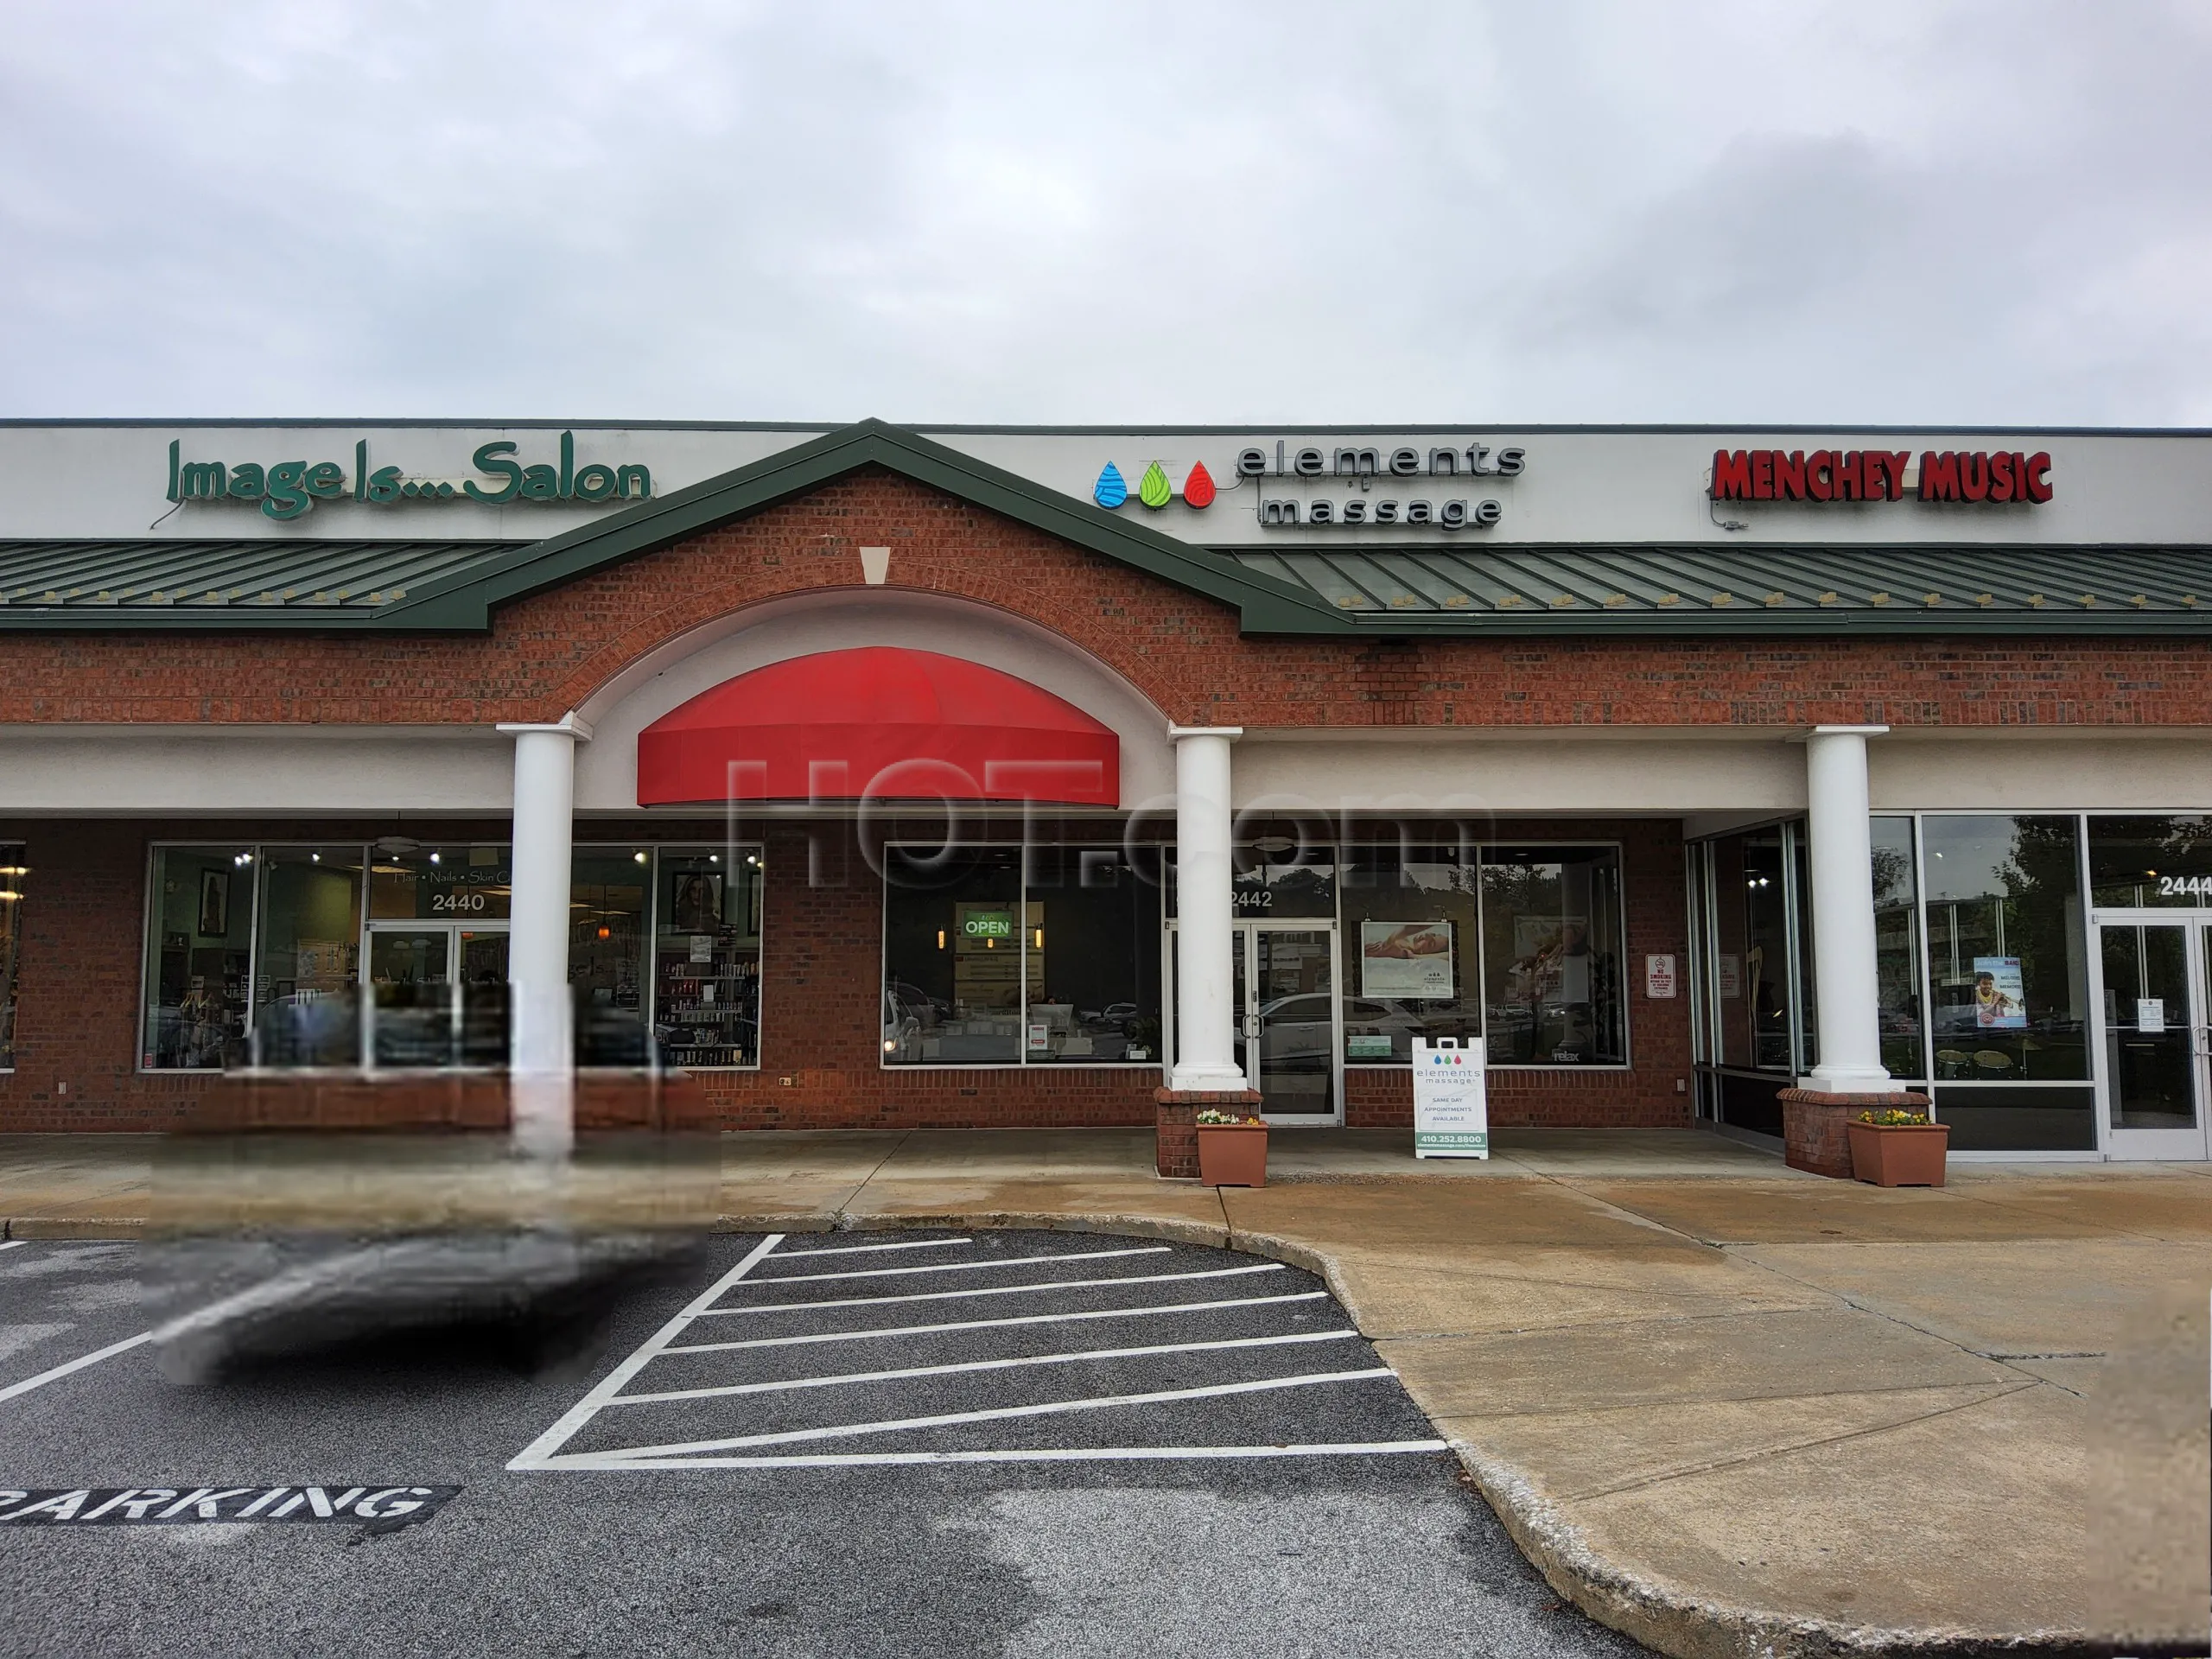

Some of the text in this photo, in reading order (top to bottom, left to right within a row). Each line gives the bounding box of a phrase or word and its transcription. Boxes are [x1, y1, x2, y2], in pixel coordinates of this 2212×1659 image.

[1237, 441, 1525, 476] elements
[167, 438, 344, 518] Image
[463, 430, 654, 503] Salon
[1712, 449, 2053, 504] MENCHEY MUSIC
[1262, 499, 1502, 531] massage
[394, 872, 419, 883] Hair
[429, 871, 456, 883] Nails
[468, 871, 493, 883] Skin
[2160, 876, 2212, 895] 2444
[432, 894, 485, 911] 2440
[966, 921, 1009, 933] OPEN
[1554, 1051, 1580, 1062] relax
[1417, 1069, 1480, 1077] elements
